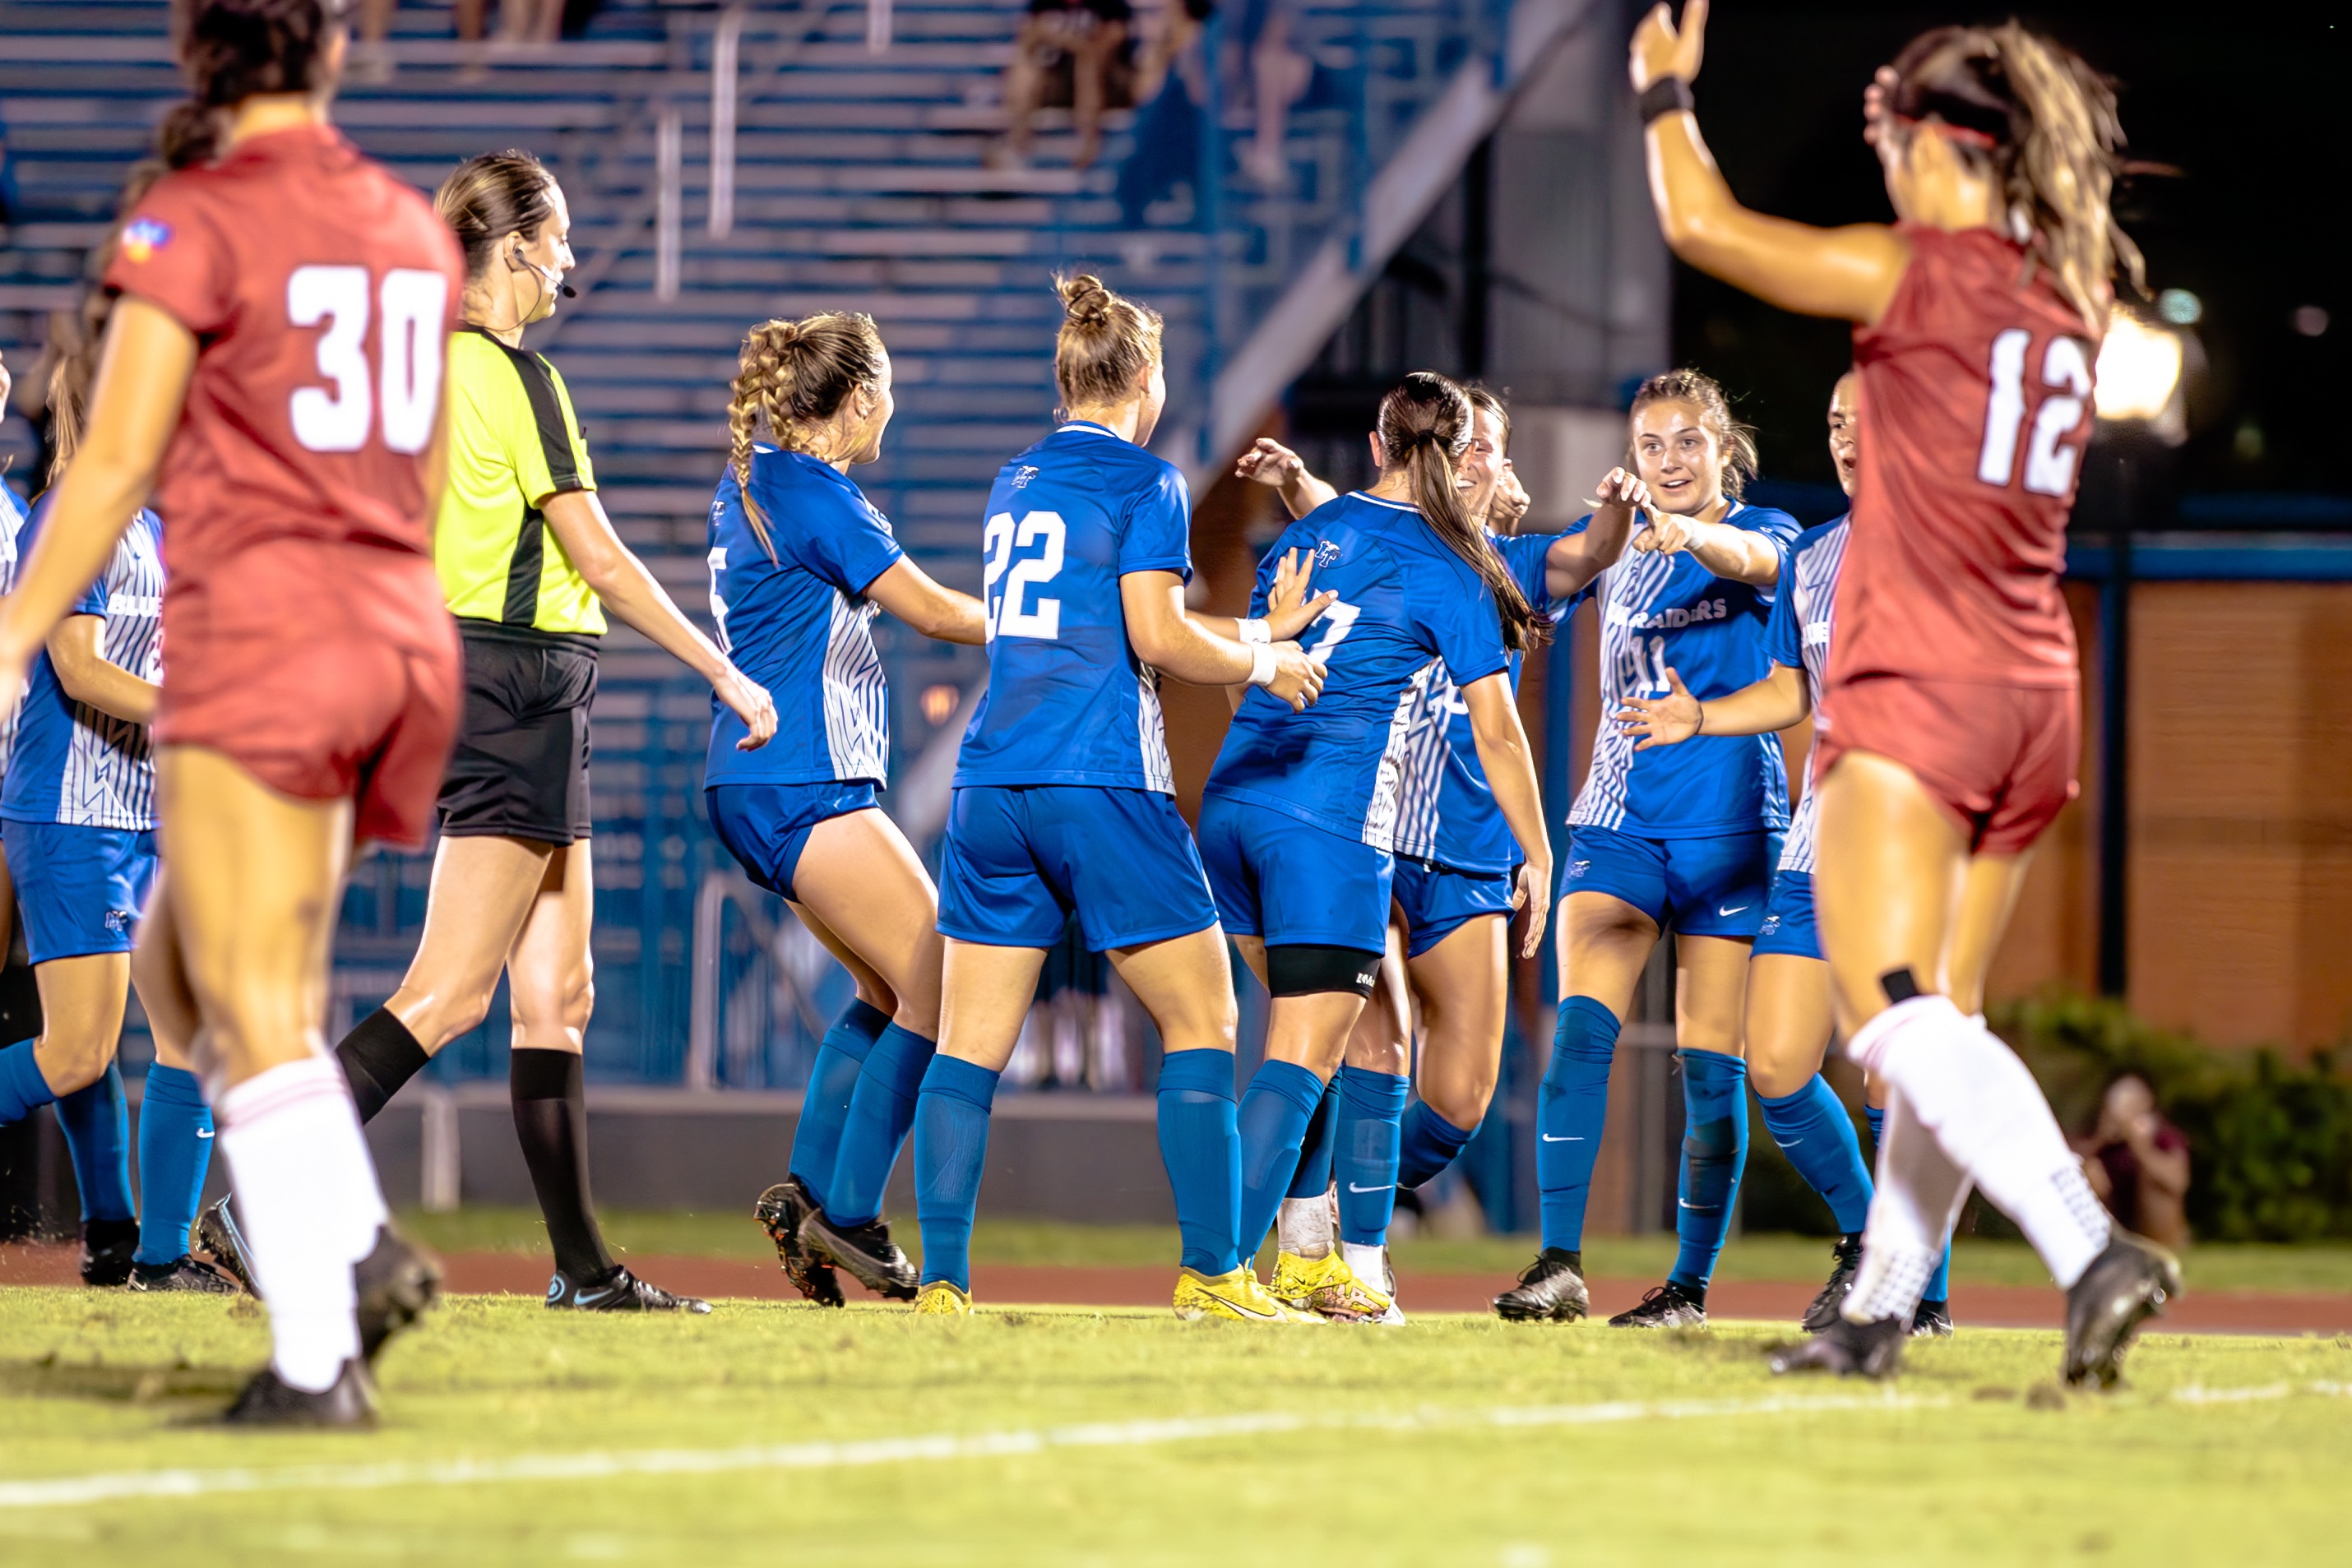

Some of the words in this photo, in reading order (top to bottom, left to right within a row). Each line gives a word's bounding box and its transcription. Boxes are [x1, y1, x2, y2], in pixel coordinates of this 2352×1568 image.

[287, 265, 447, 456] 30
[1978, 327, 2093, 497] 12
[983, 509, 1067, 644] 22
